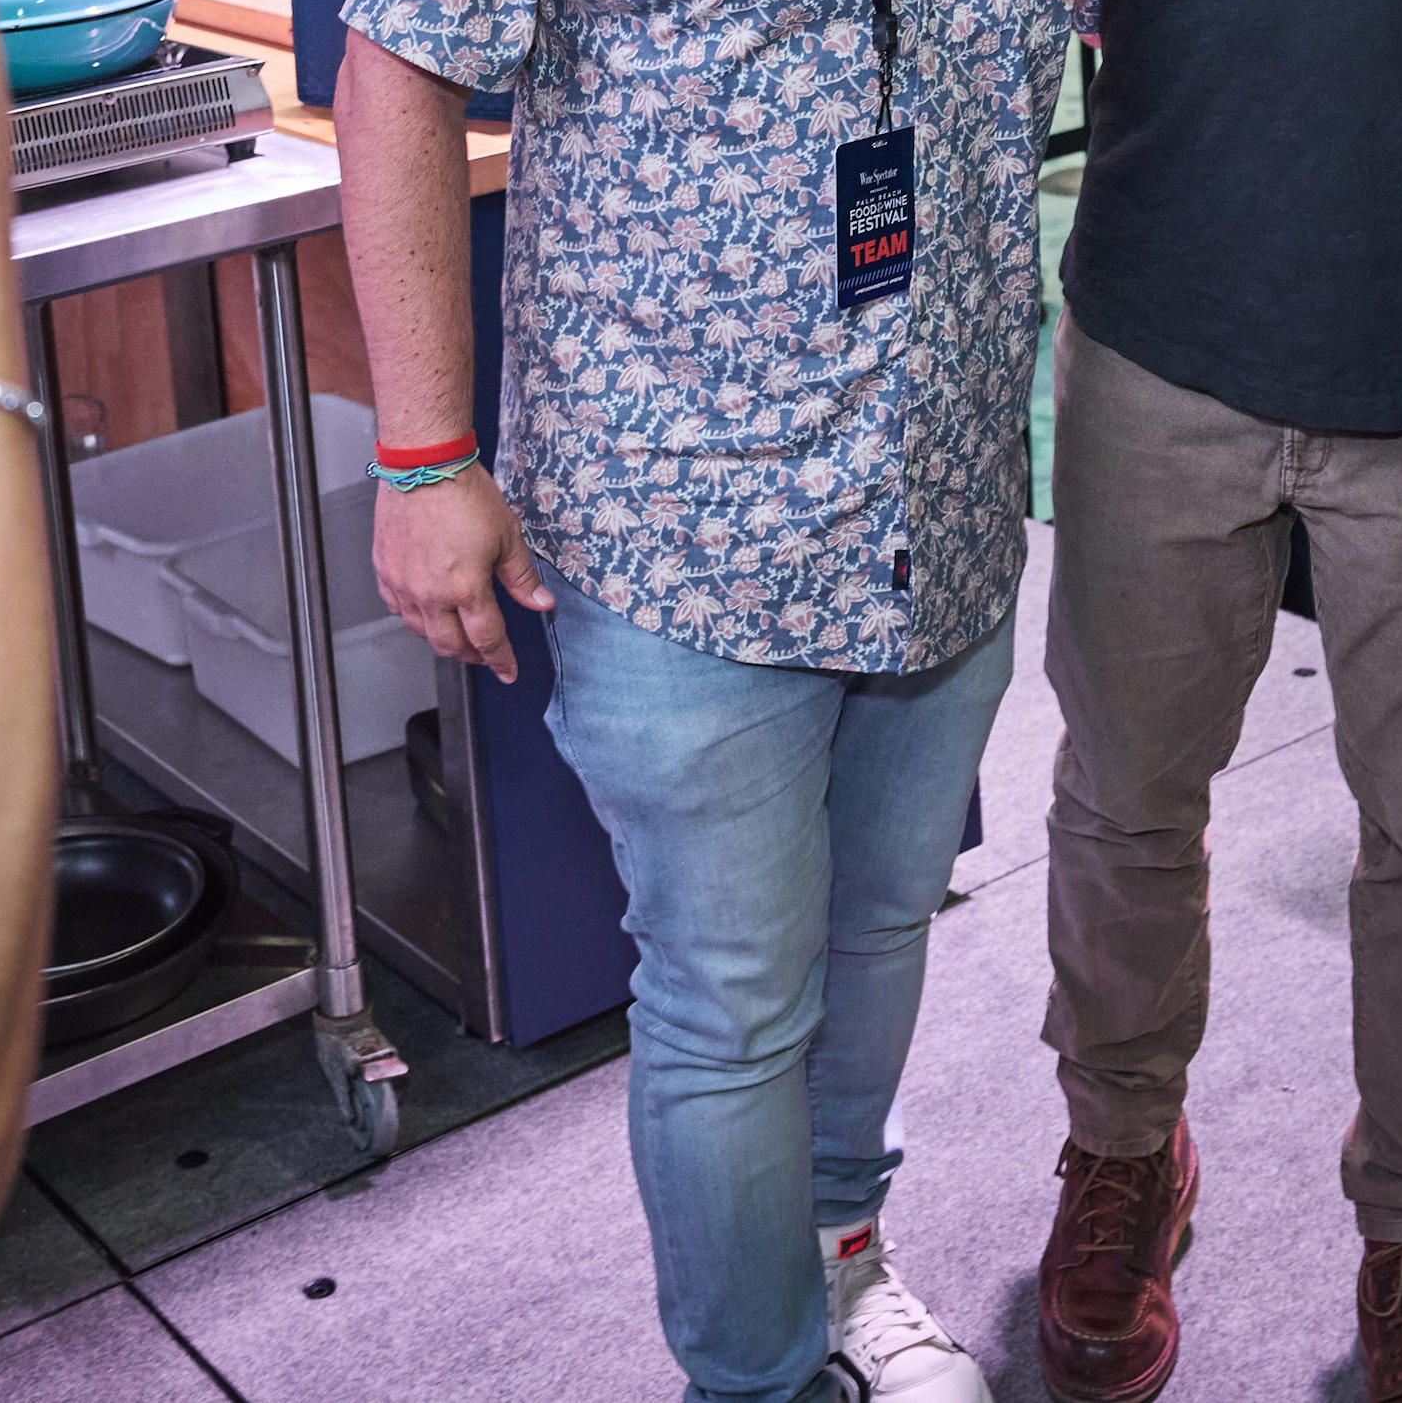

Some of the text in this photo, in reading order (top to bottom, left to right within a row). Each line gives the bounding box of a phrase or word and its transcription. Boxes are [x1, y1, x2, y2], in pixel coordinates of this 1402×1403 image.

[856, 190, 902, 206] PALM BEACH
[849, 210, 908, 237] FESTIVAL
[850, 229, 907, 268] TEAM
